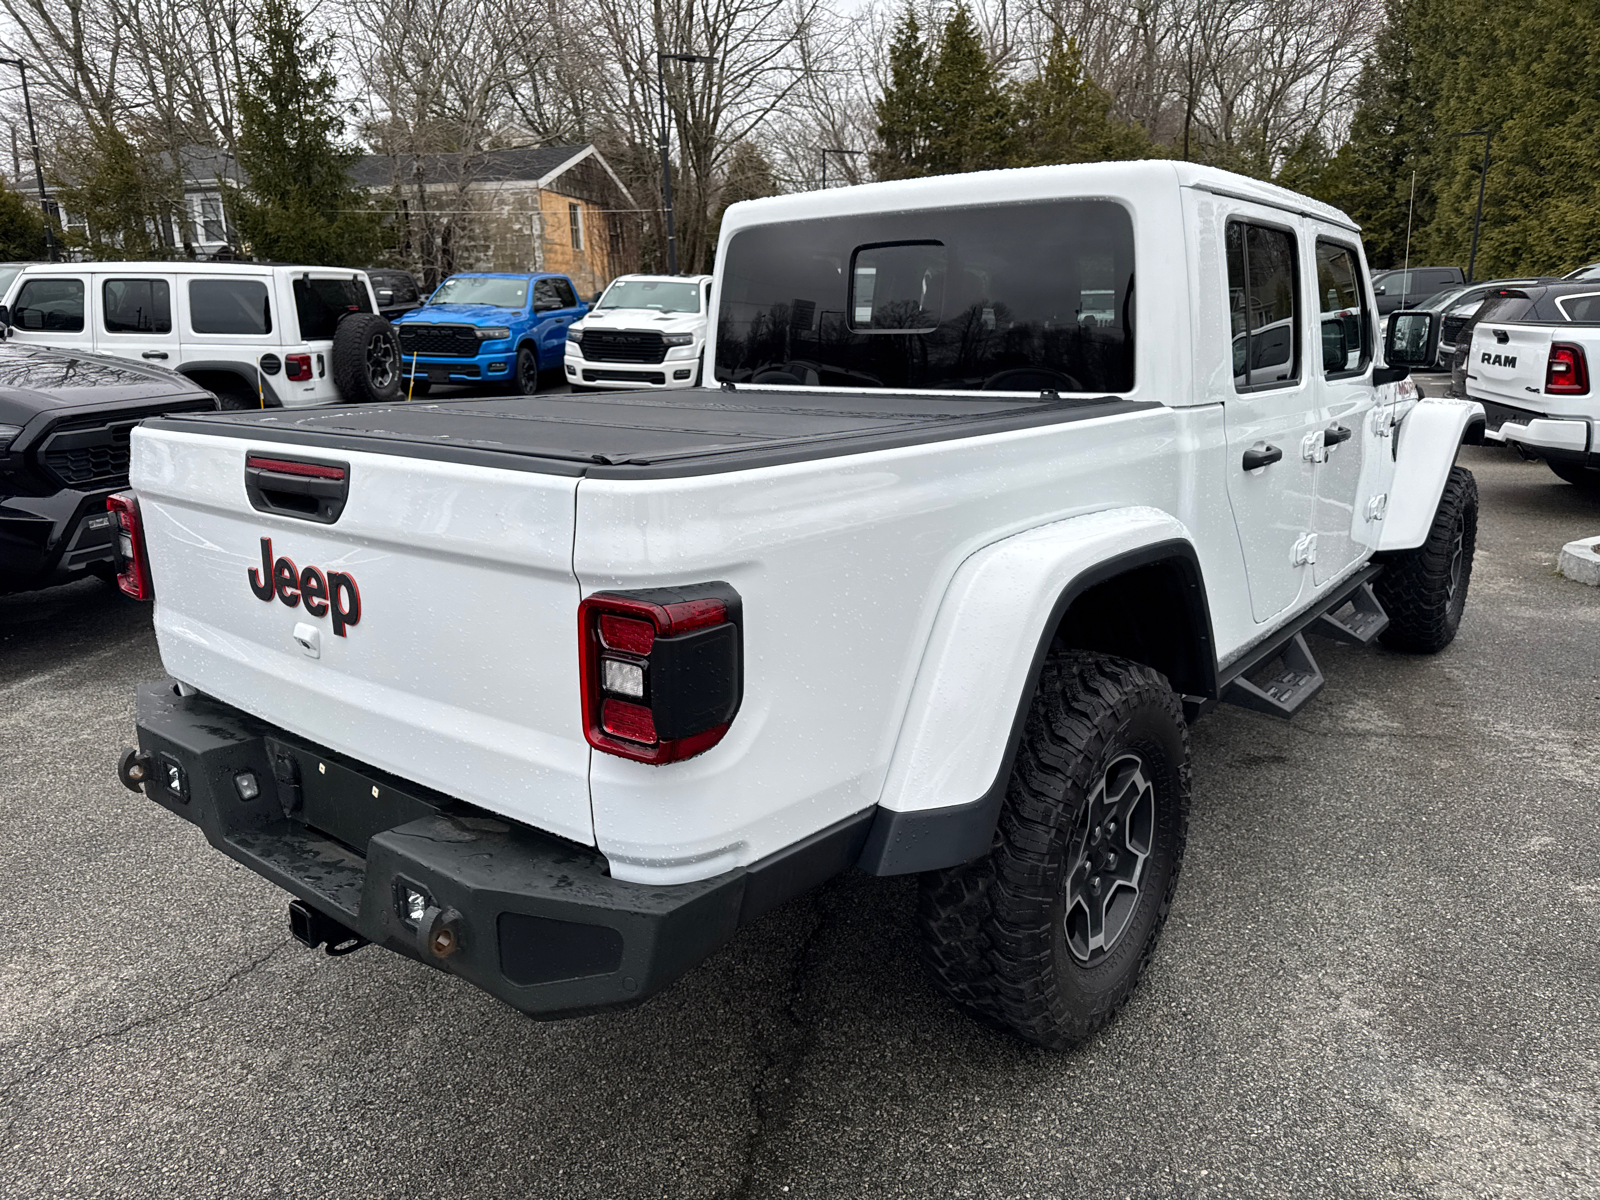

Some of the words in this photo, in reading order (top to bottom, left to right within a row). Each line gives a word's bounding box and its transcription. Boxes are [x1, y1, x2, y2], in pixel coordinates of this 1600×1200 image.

[417, 329, 454, 337] RAM
[601, 336, 641, 344] RAM
[1480, 352, 1518, 369] RAM
[247, 536, 362, 638] Jeep
